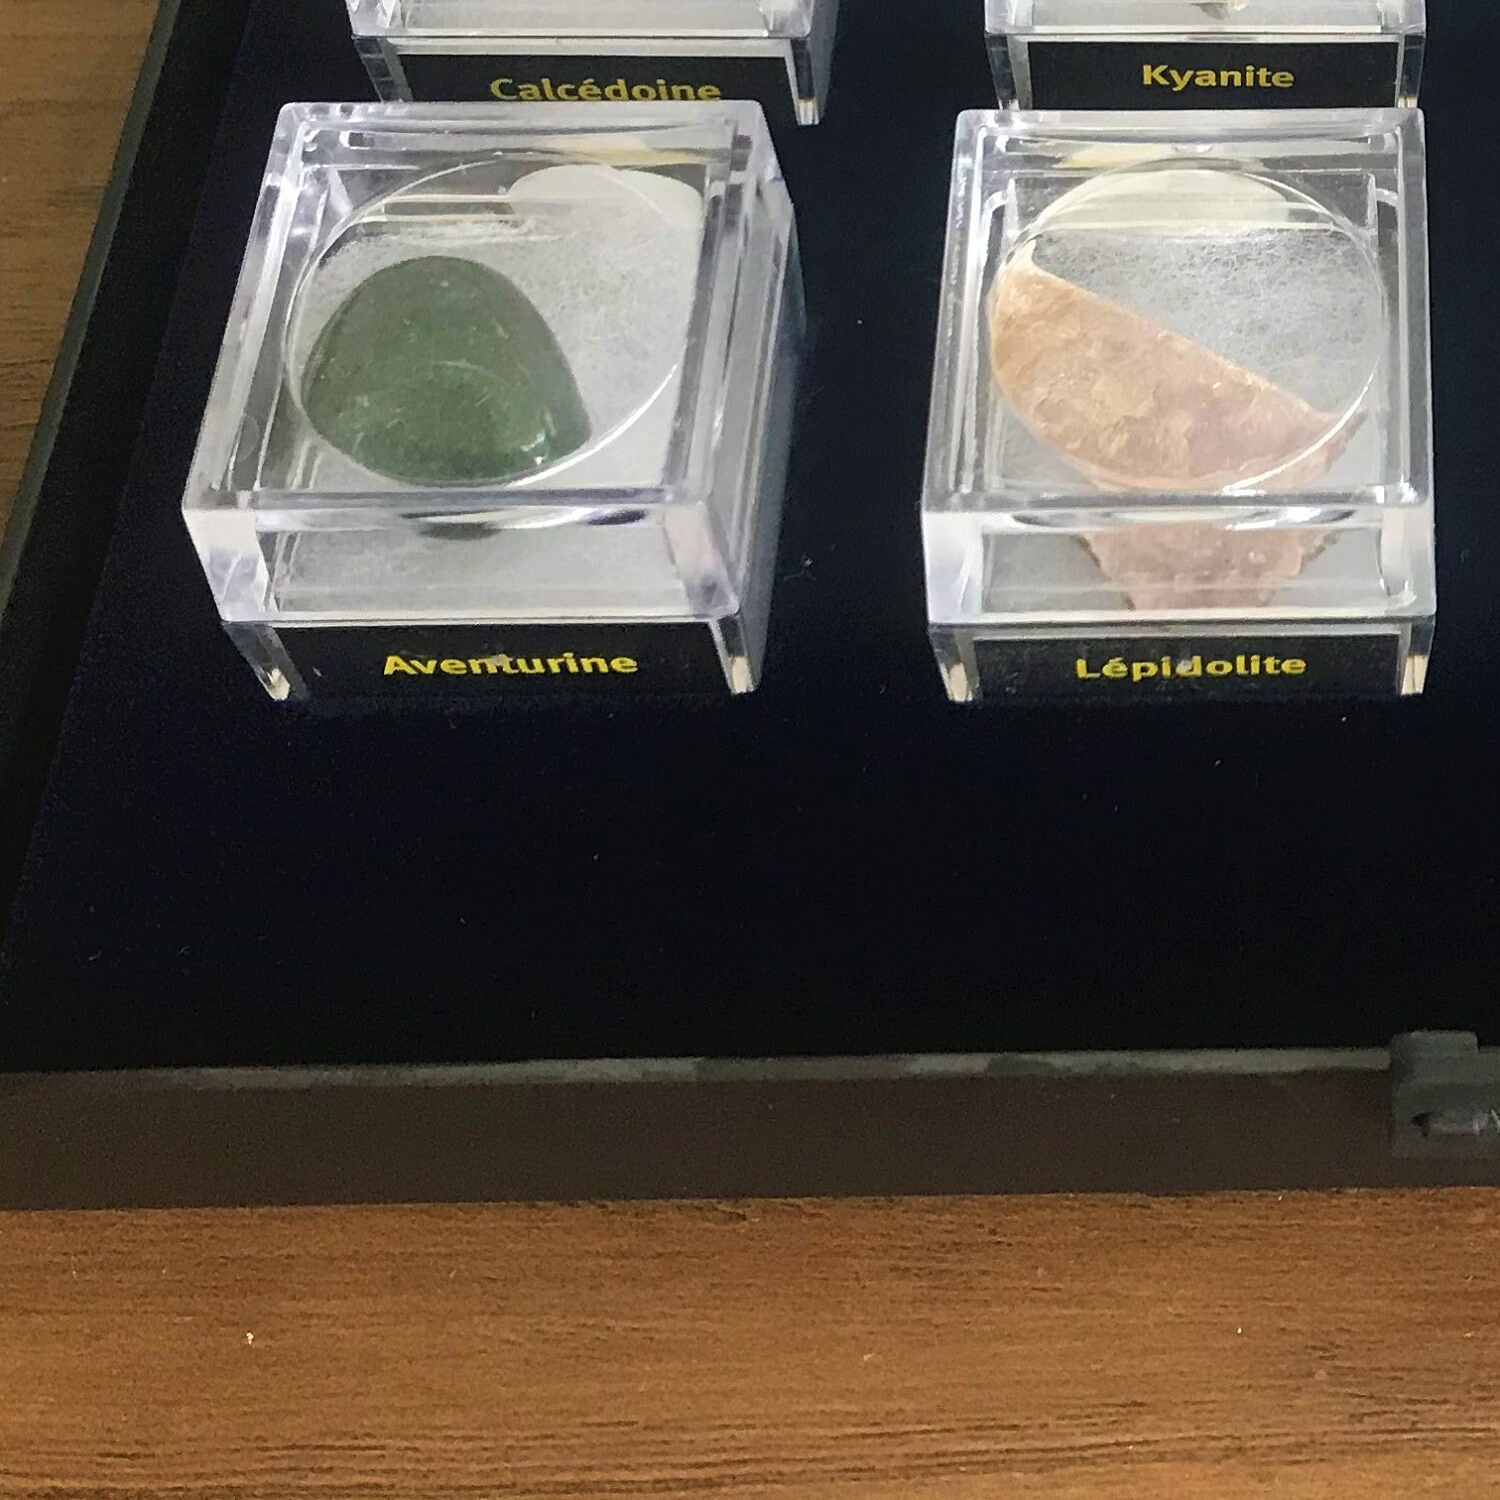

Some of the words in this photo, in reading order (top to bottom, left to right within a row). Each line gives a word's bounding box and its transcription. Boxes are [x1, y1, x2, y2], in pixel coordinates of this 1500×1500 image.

[489, 77, 721, 101] Calcédoine
[1142, 64, 1295, 92] Kyanite
[383, 652, 638, 676] Aventurine
[1075, 653, 1306, 682] Lépidolite
